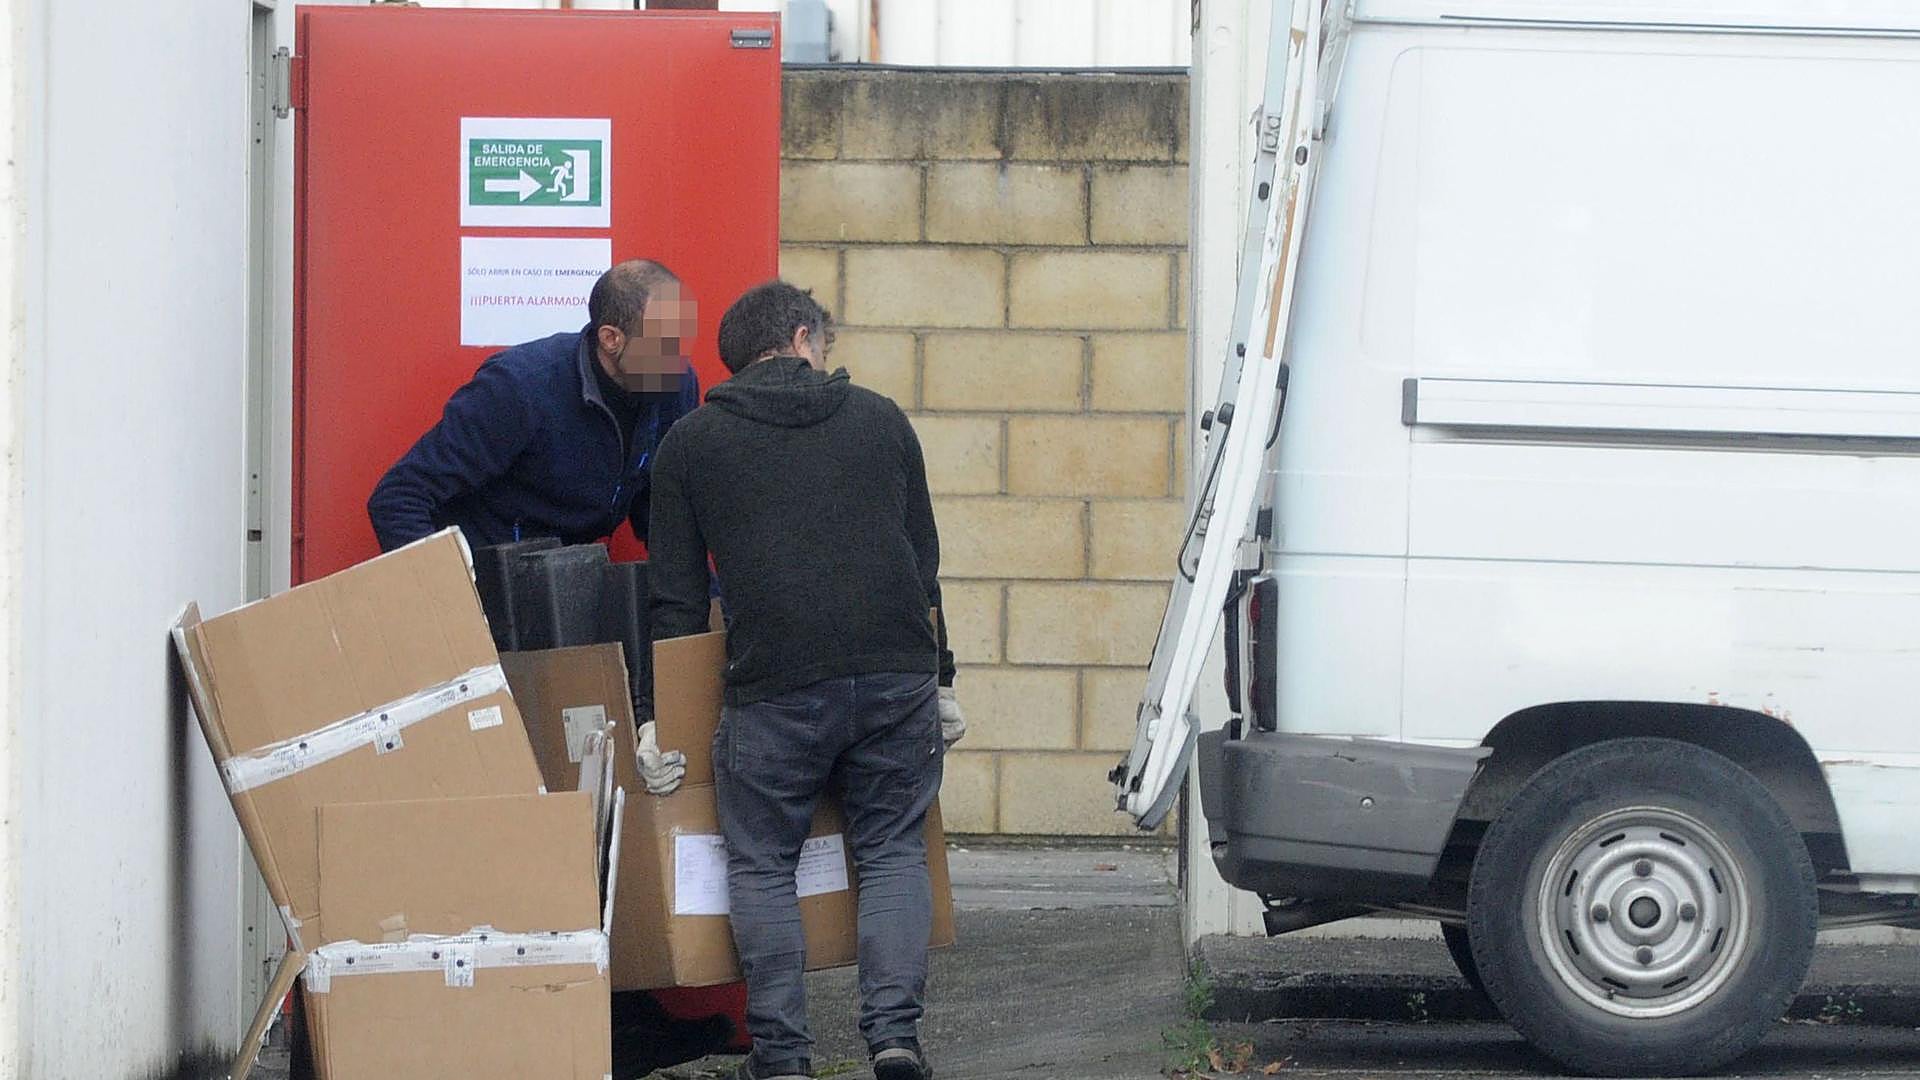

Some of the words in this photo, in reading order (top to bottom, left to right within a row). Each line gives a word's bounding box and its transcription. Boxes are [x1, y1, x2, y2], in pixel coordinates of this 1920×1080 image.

[482, 143, 525, 155] SALIDA
[527, 143, 543, 155] DE
[474, 156, 551, 167] EMERGENCIA
[488, 268, 510, 277] ABRIR
[511, 268, 521, 277] EN
[522, 268, 542, 277] CASO
[543, 269, 553, 277] DE
[555, 269, 603, 277] EMERGENCIA
